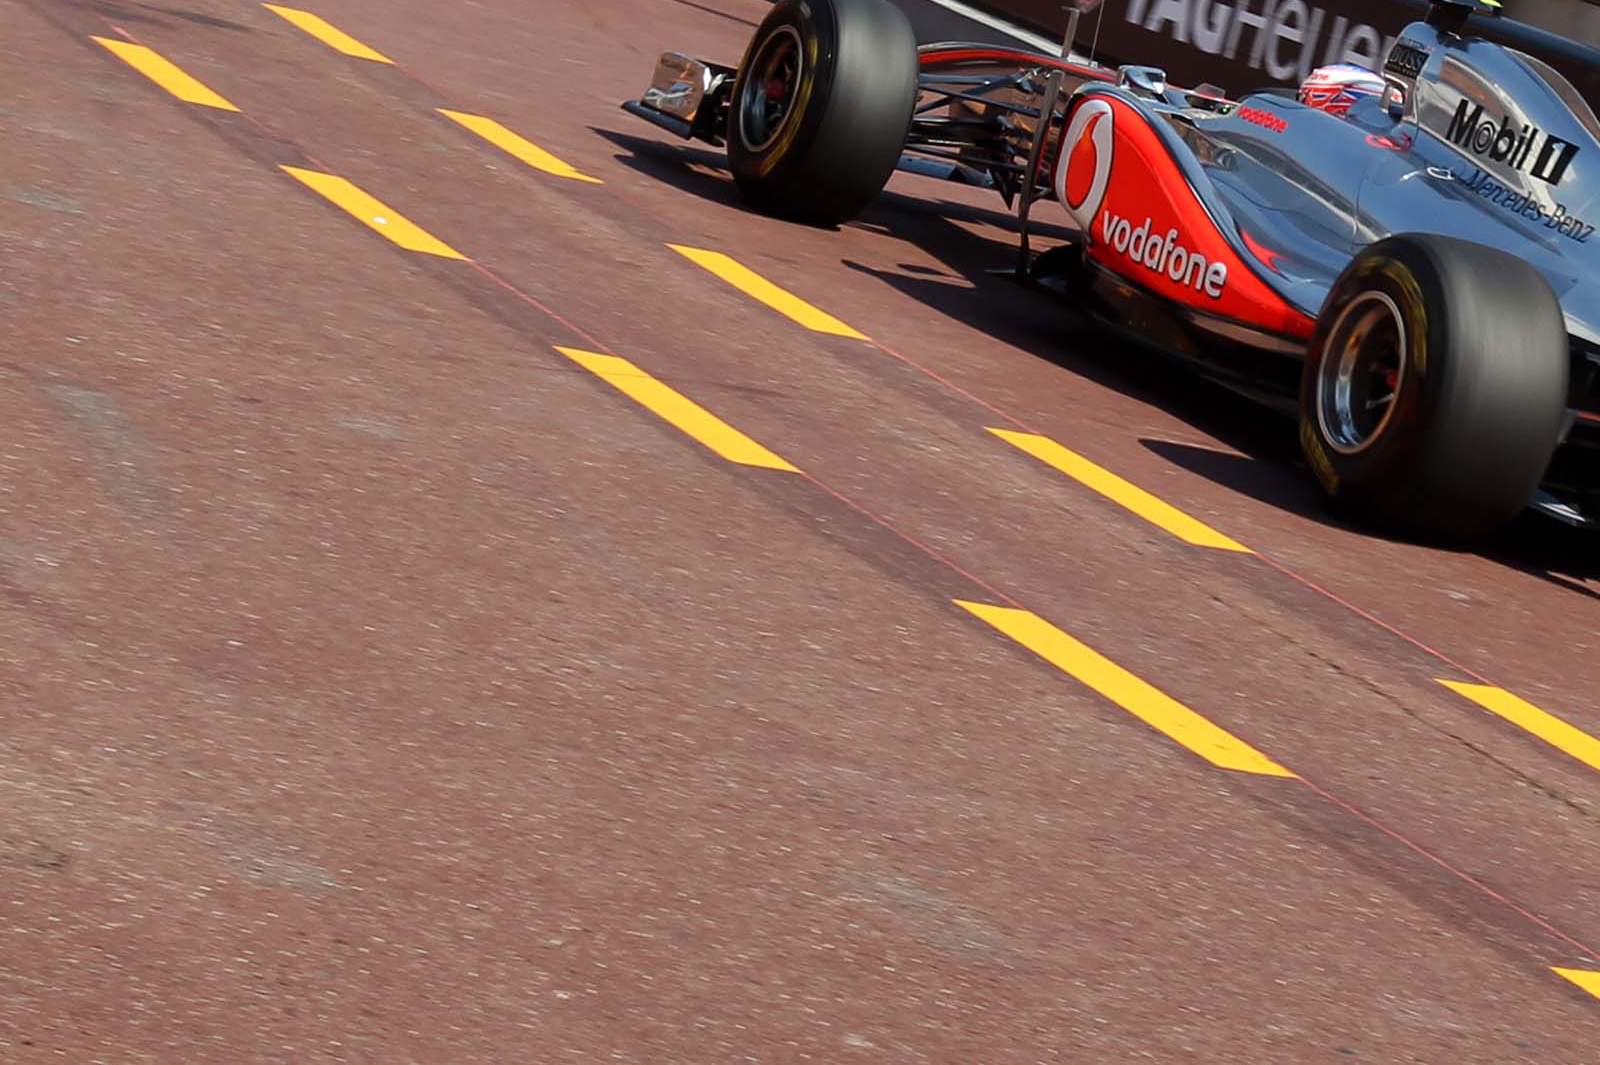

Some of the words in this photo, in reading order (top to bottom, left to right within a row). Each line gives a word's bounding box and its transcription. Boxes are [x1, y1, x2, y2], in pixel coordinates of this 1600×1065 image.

[1446, 98, 1539, 171] Mobil
[1537, 137, 1572, 183] 1
[1464, 167, 1596, 245] Mercedes-Benz
[1102, 209, 1228, 298] vodafone
